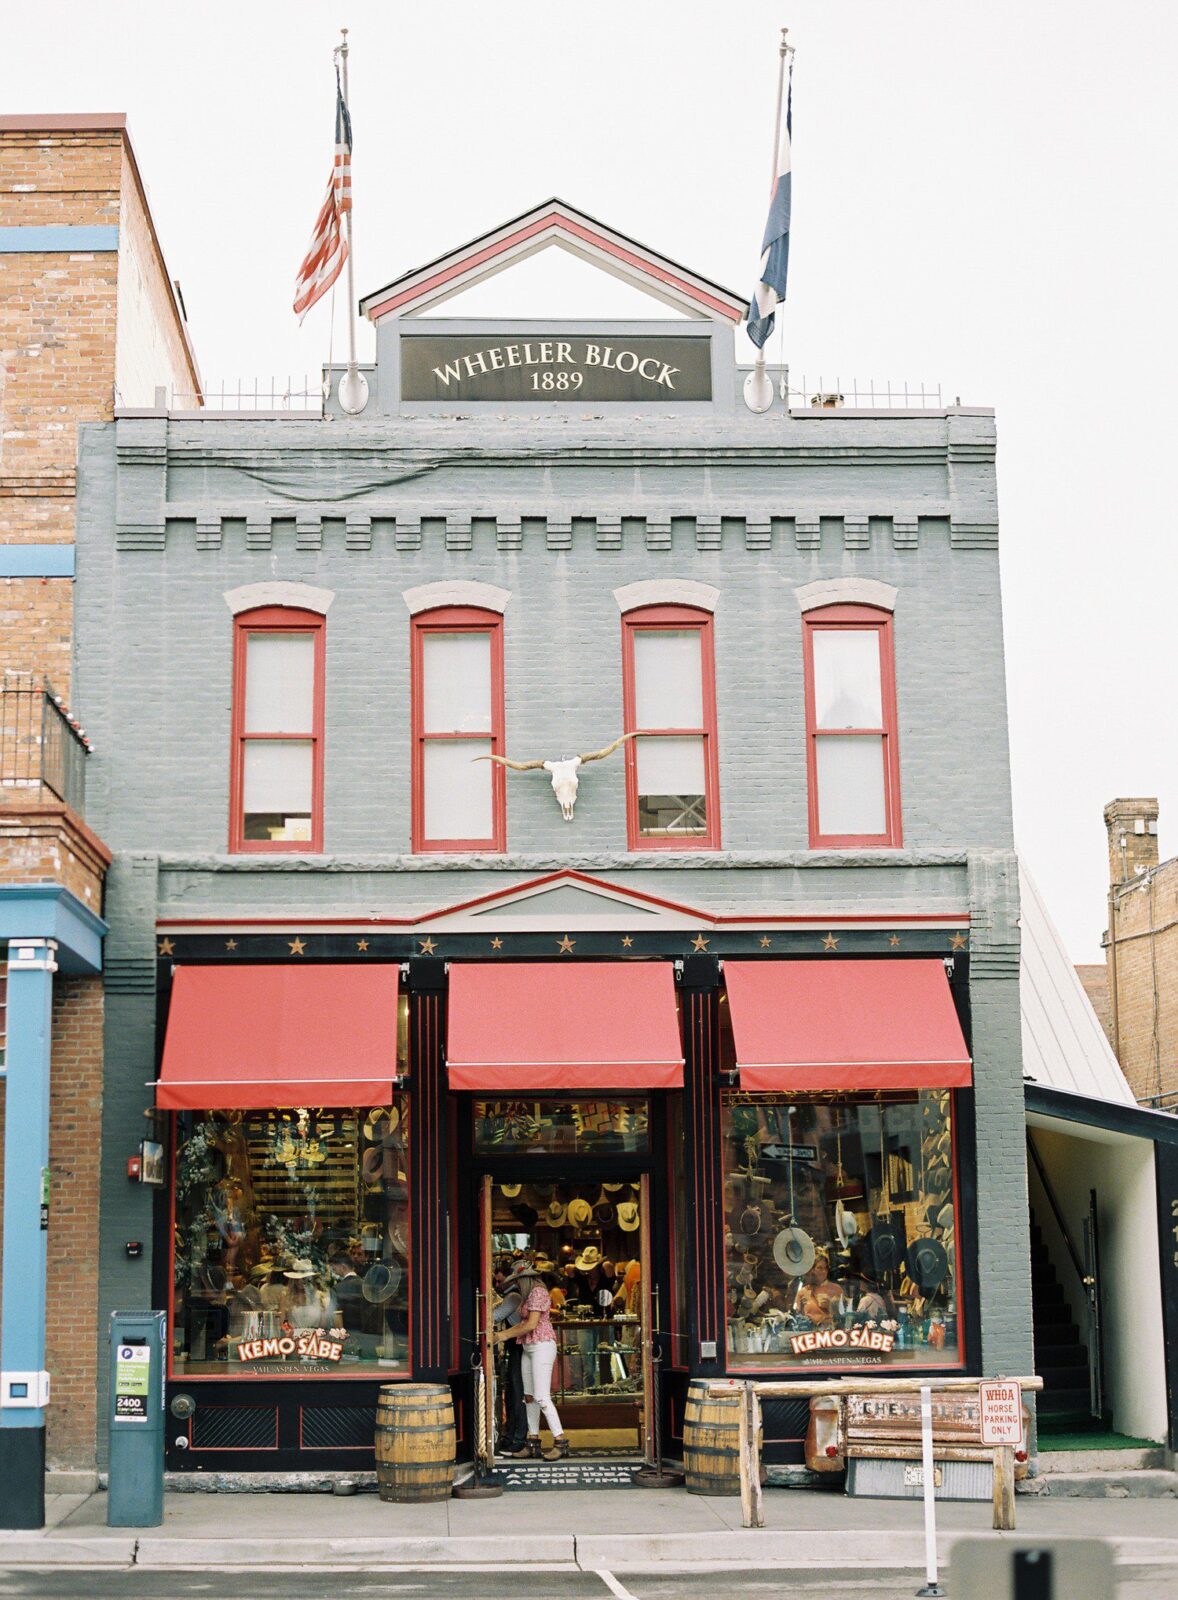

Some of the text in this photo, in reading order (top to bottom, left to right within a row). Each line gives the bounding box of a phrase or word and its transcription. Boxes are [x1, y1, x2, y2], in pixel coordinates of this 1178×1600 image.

[432, 342, 681, 390] WHEELER BLOCK
[530, 371, 584, 392] 1889
[790, 1323, 894, 1355] KEMO SABE
[238, 1331, 343, 1362] KEMO SABE
[828, 1357, 852, 1365] ASPEN
[855, 1356, 882, 1364] VEGAS
[253, 1366, 271, 1374] VAIL
[303, 1365, 330, 1373] VEGAS
[985, 1389, 1014, 1401] WHOA
[117, 1398, 141, 1408] 2400
[987, 1404, 1013, 1413] HORSE
[984, 1415, 1018, 1424] PARKING
[991, 1426, 1012, 1436] ONLY
